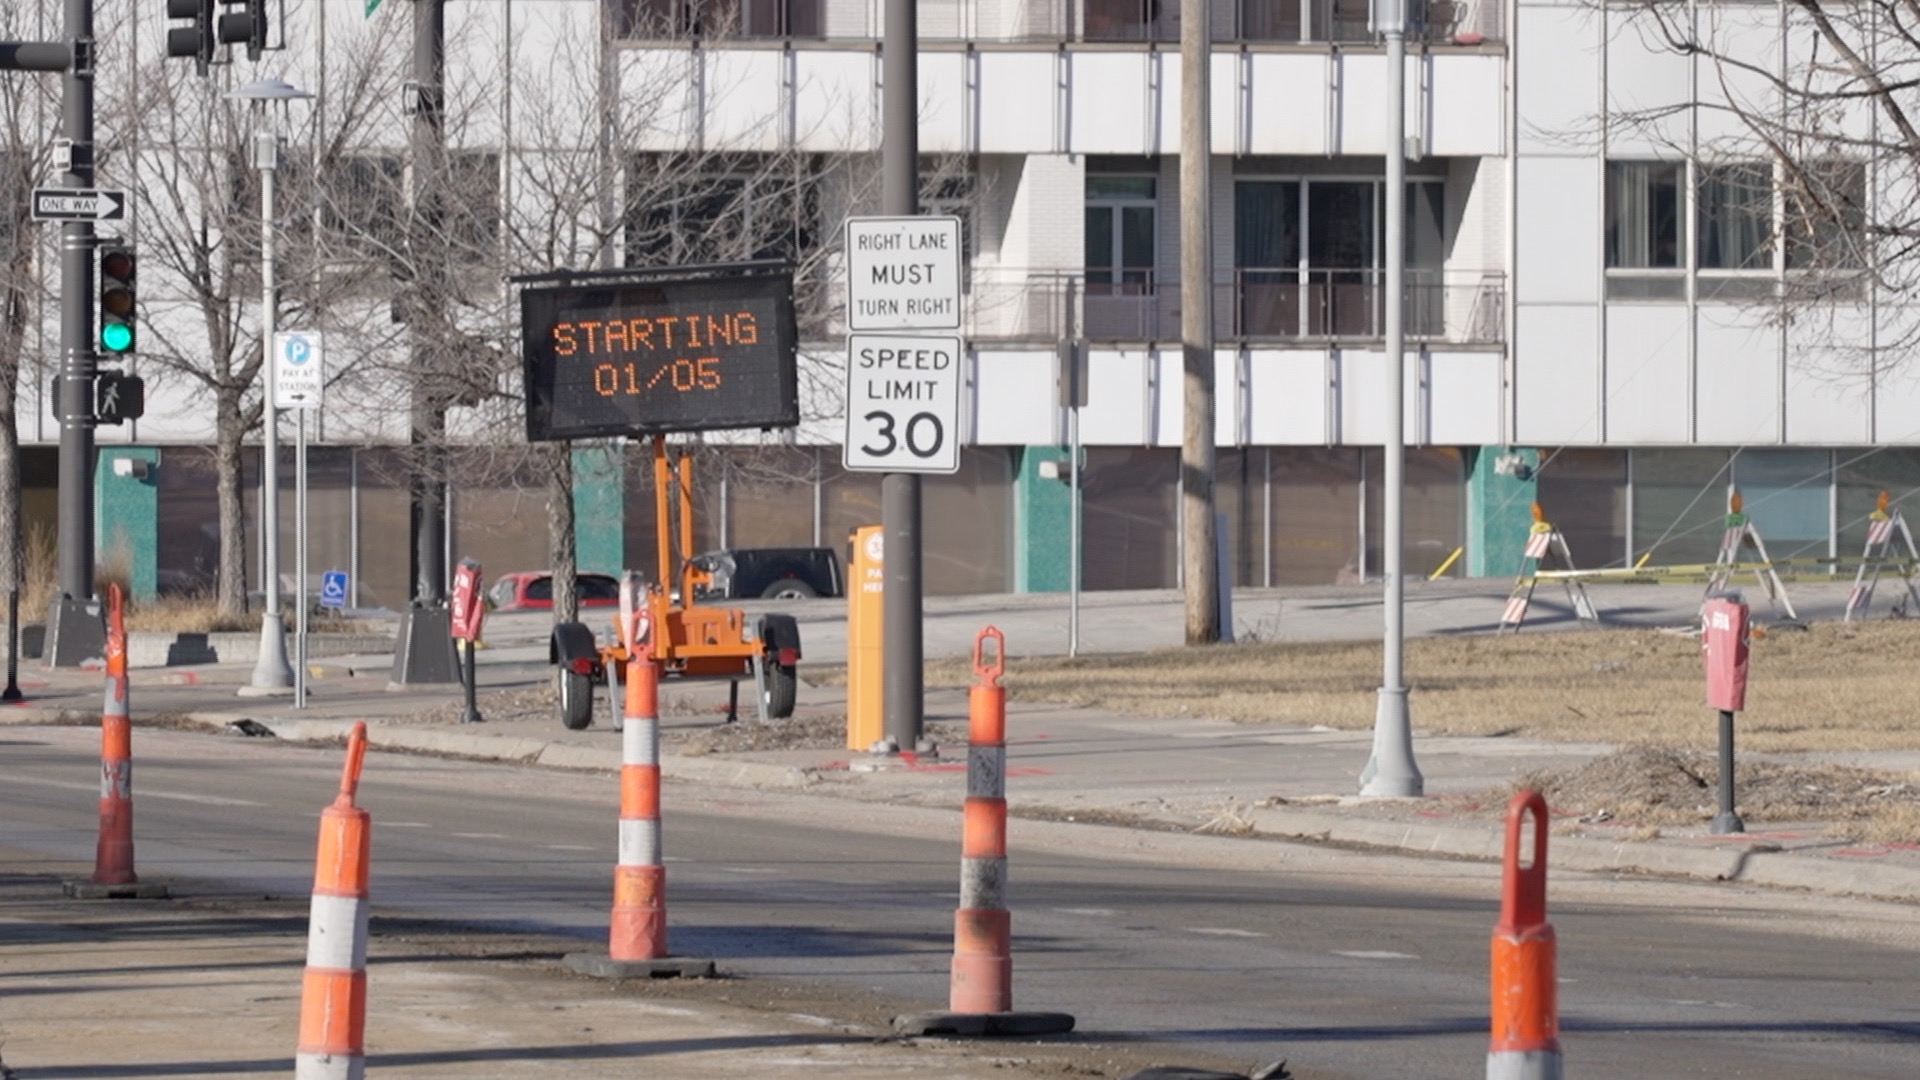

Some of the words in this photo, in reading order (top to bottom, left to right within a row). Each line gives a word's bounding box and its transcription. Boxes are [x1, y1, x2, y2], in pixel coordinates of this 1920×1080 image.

[42, 198, 66, 211] ONE
[72, 199, 98, 211] WAY
[858, 232, 902, 251] RIGHT
[909, 232, 948, 251] LANE
[872, 263, 936, 285] MUST
[857, 298, 899, 316] TURN
[907, 297, 952, 315] RIGHT
[552, 311, 758, 357] STARTING
[291, 341, 306, 362] P
[859, 347, 950, 371] SPEED
[282, 368, 300, 378] PAY
[303, 367, 315, 378] AT
[594, 357, 721, 397] 01/05
[279, 381, 318, 392] STATION
[868, 379, 939, 401] LIMIT
[860, 409, 944, 459] 30
[866, 567, 884, 580] PA
